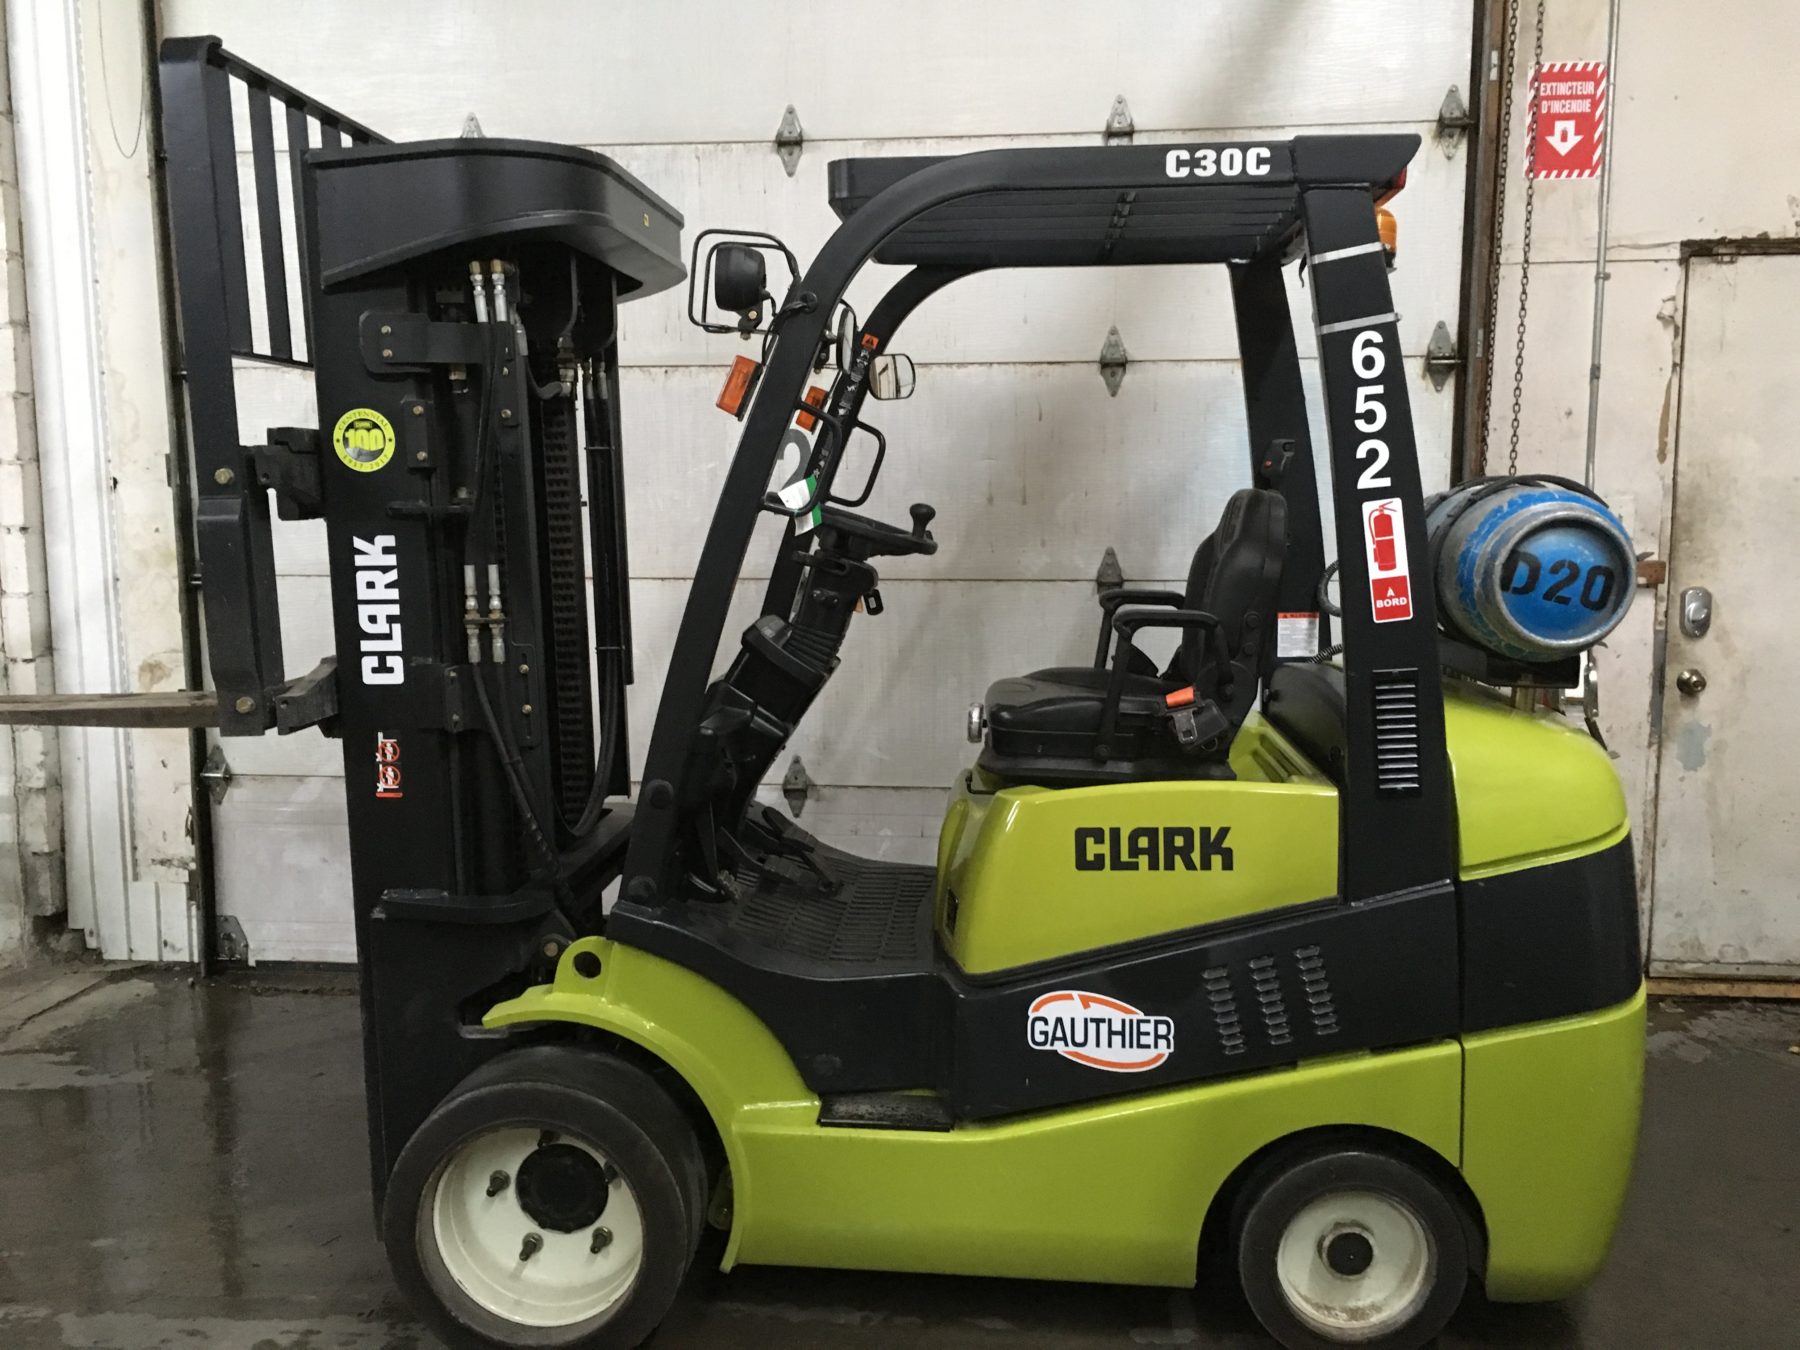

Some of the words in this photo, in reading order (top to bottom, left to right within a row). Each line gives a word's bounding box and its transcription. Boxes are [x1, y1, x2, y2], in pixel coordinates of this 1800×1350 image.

[1540, 81, 1595, 96] EXTINCTEUR
[1541, 99, 1592, 114] D'INCENDIE
[1165, 146, 1271, 178] C30C
[1351, 330, 1392, 490] 652
[345, 428, 385, 452] 100
[1500, 550, 1616, 611] D20
[352, 534, 405, 685] CLARK
[1376, 597, 1408, 608] BORD
[1074, 826, 1235, 871] CLARK
[1030, 1015, 1173, 1050] GAUTHIER
